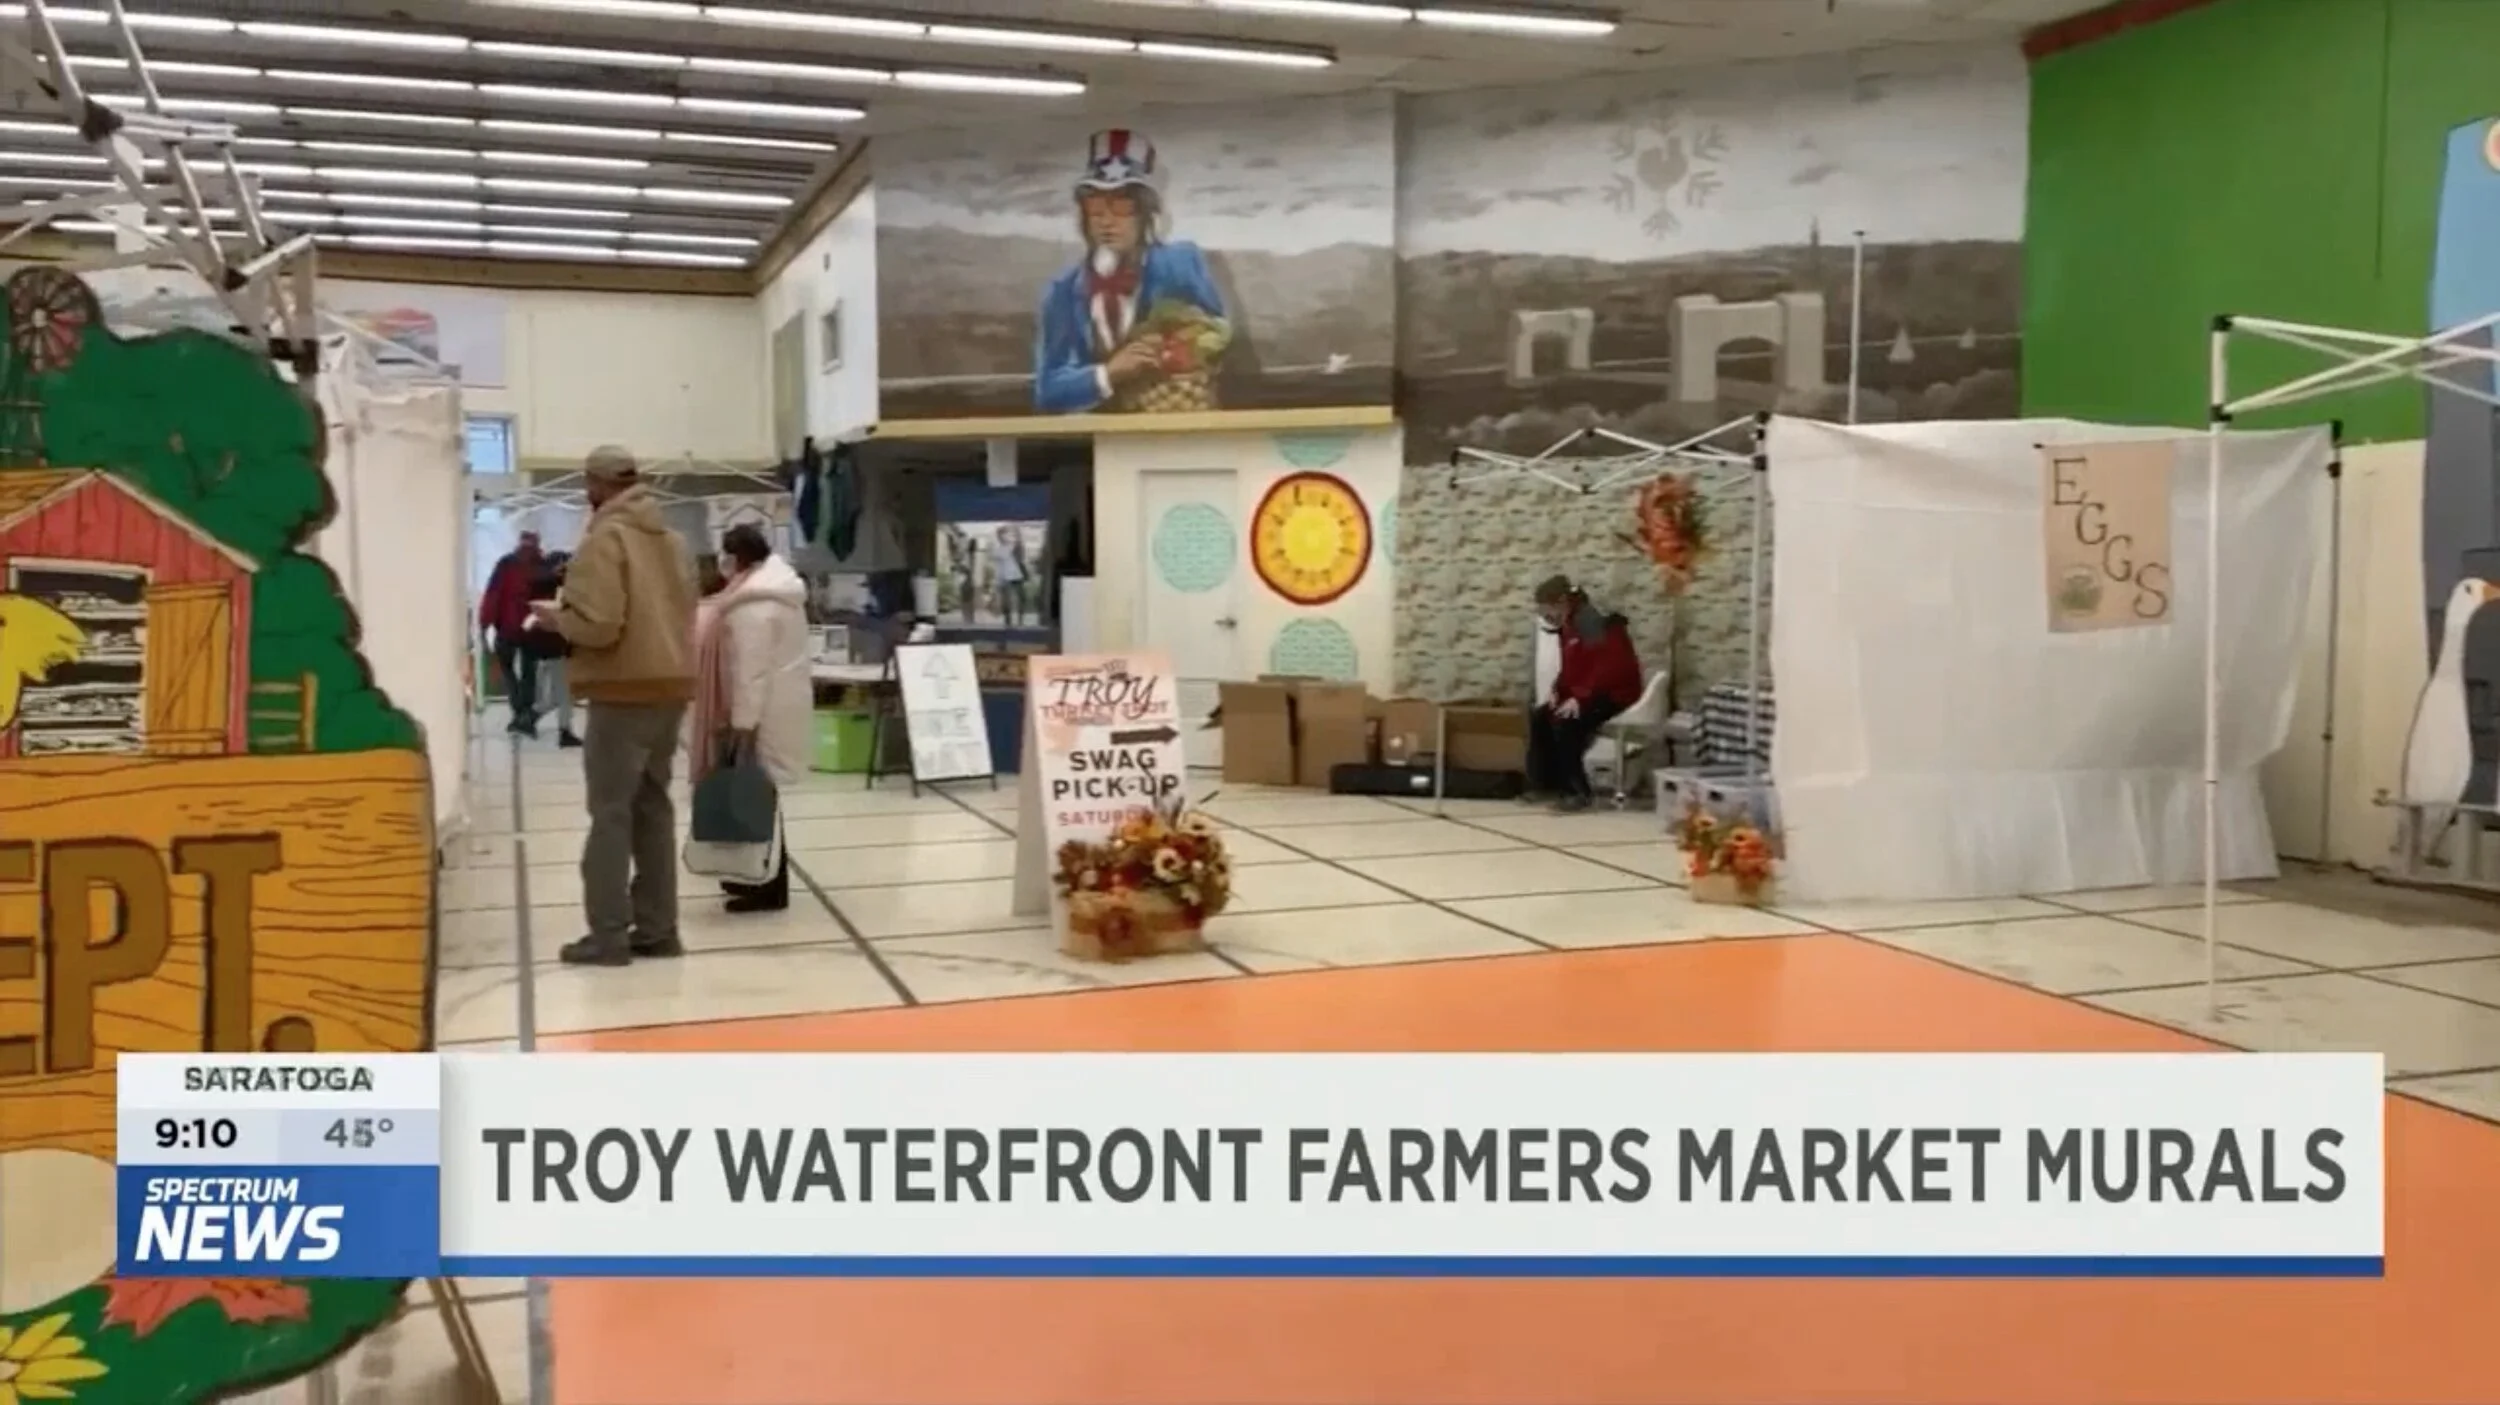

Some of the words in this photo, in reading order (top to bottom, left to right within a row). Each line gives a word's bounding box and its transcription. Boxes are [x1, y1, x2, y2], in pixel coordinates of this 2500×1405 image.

[2053, 456, 2170, 619] EGGS
[1048, 675, 1158, 720] TROY
[1069, 749, 1156, 772] SWAG
[1053, 770, 1179, 801] PICK-UP
